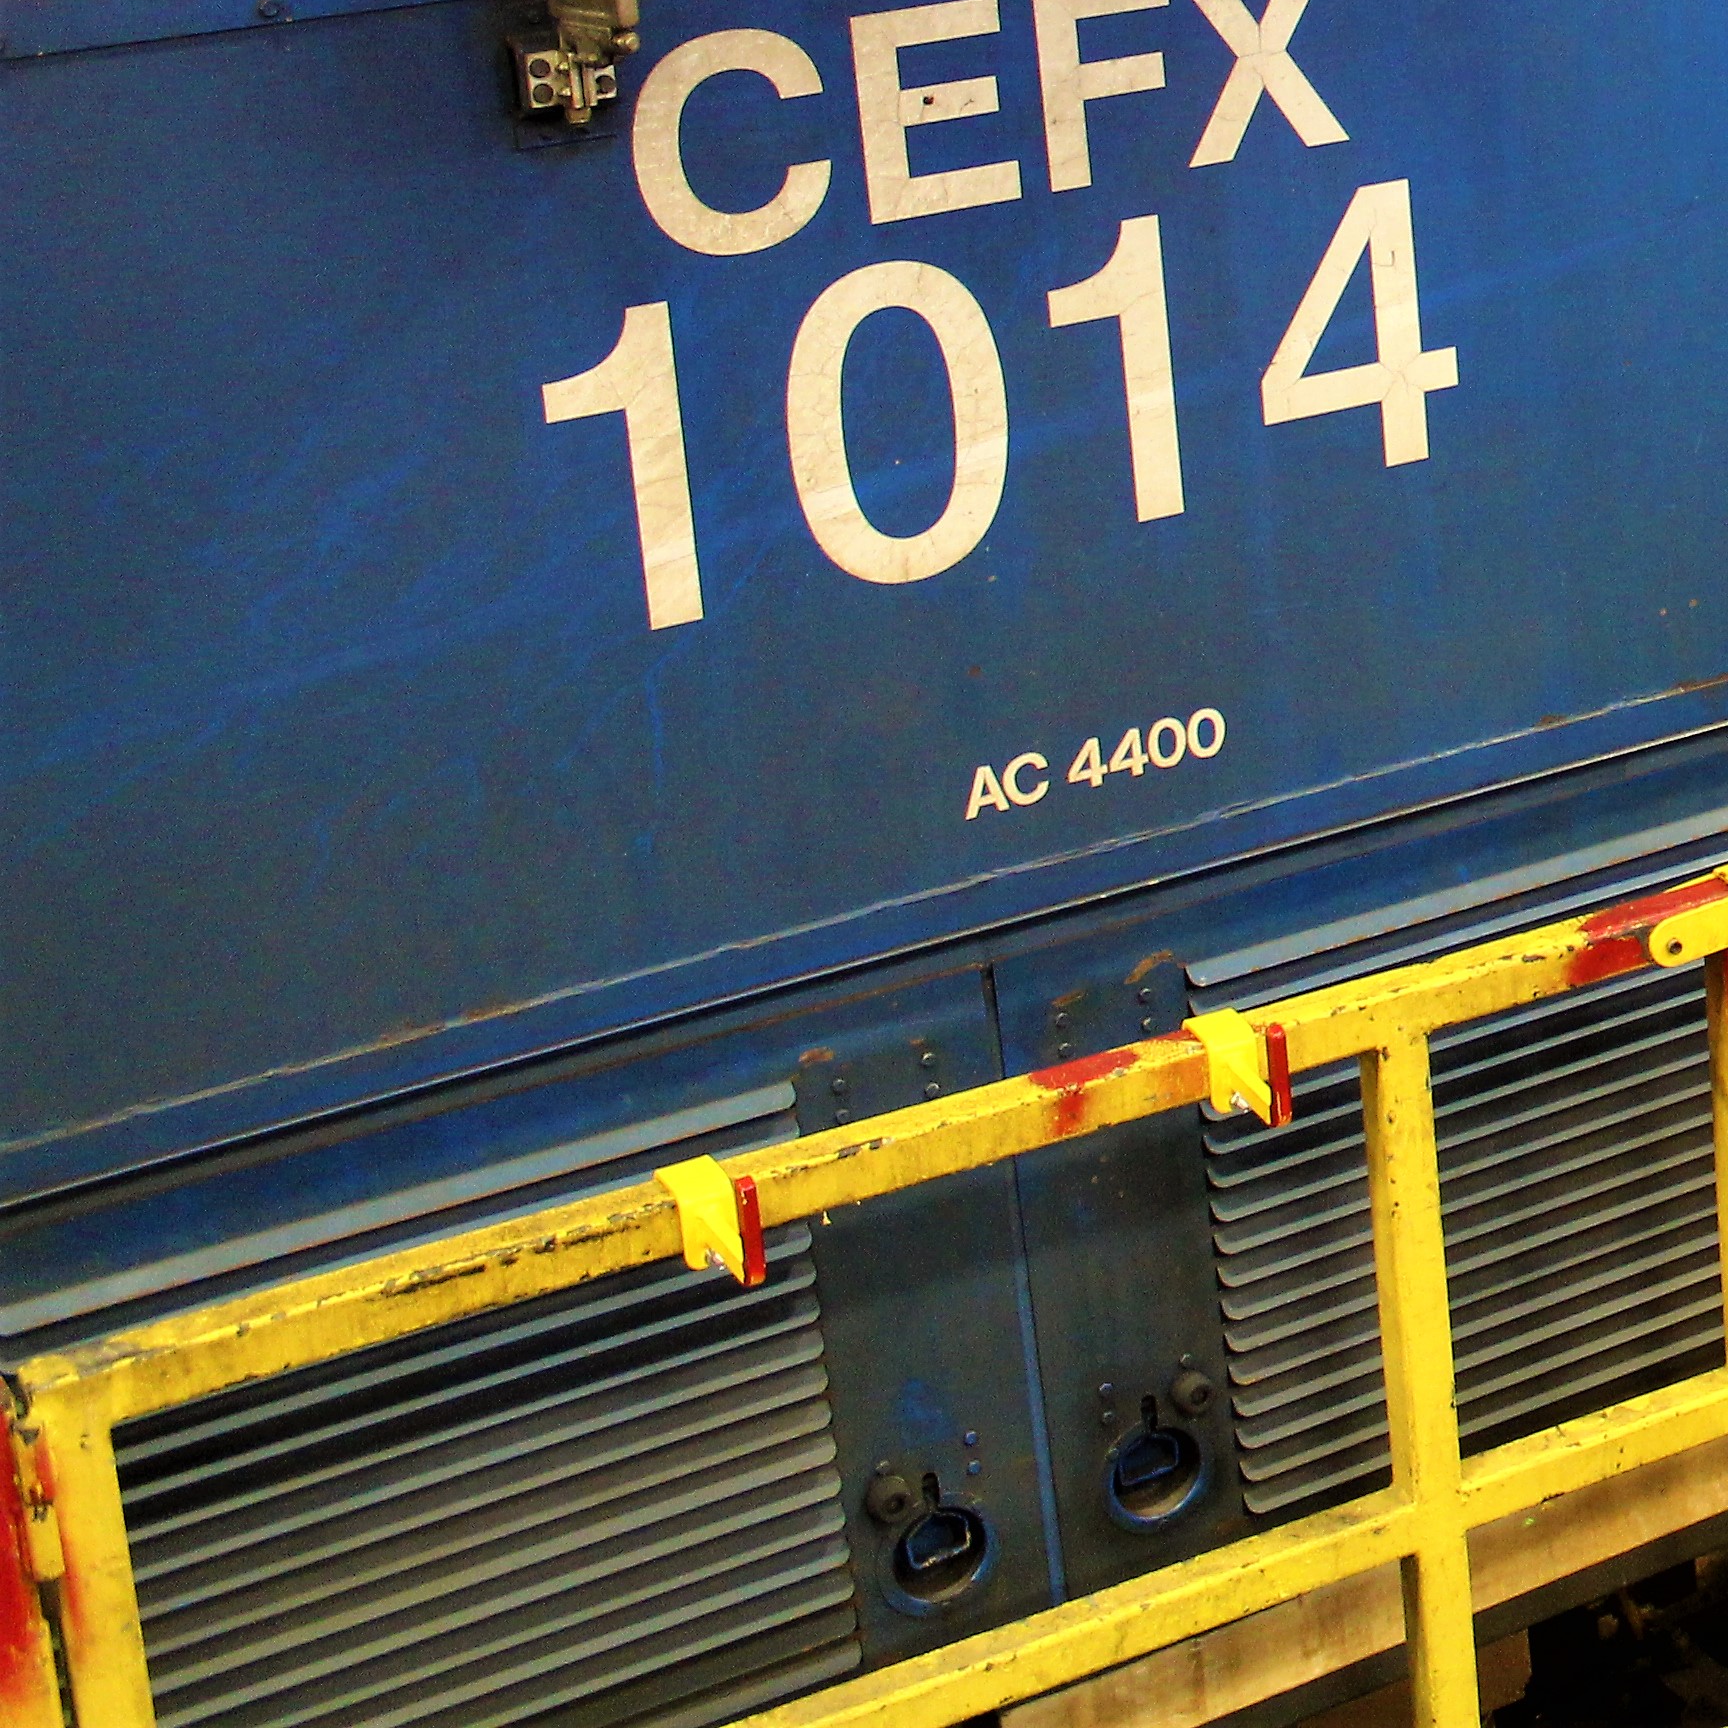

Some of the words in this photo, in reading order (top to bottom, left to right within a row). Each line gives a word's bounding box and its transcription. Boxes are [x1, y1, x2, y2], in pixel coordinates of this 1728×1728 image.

[540, 178, 1459, 632] 1014
[965, 752, 1050, 821] AC
[1066, 707, 1226, 788] 4400
